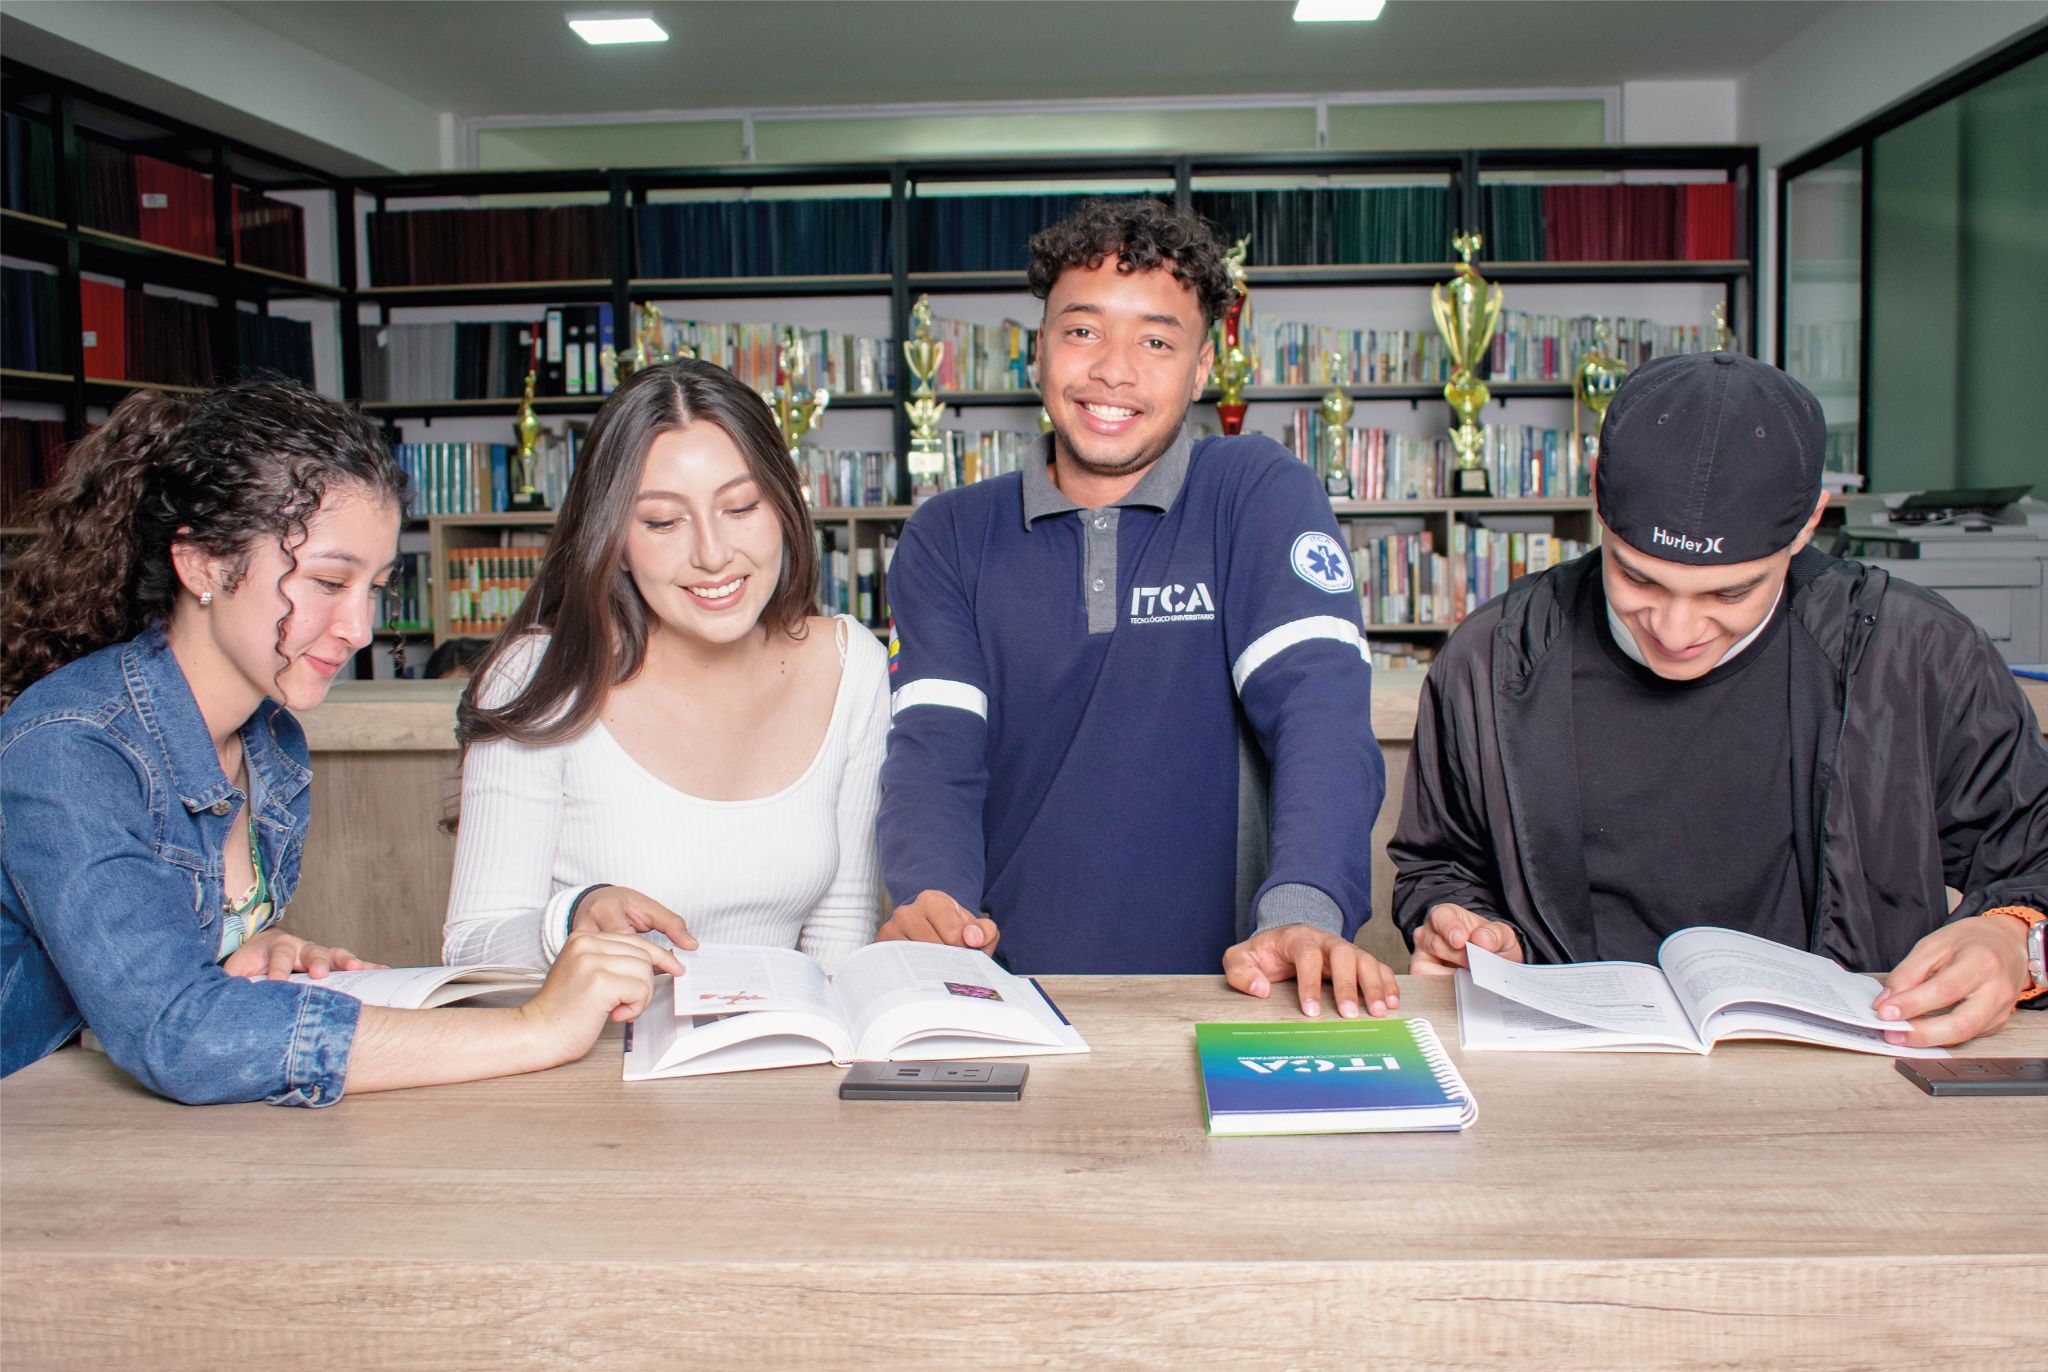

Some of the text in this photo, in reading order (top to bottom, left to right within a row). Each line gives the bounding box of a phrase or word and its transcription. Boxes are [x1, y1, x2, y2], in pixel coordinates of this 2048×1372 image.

[1652, 526, 1703, 552] Hurley
[1130, 582, 1215, 616] ITCA
[1171, 613, 1215, 621] UNIVERSITARIO
[1239, 1057, 1400, 1074] ITCA
